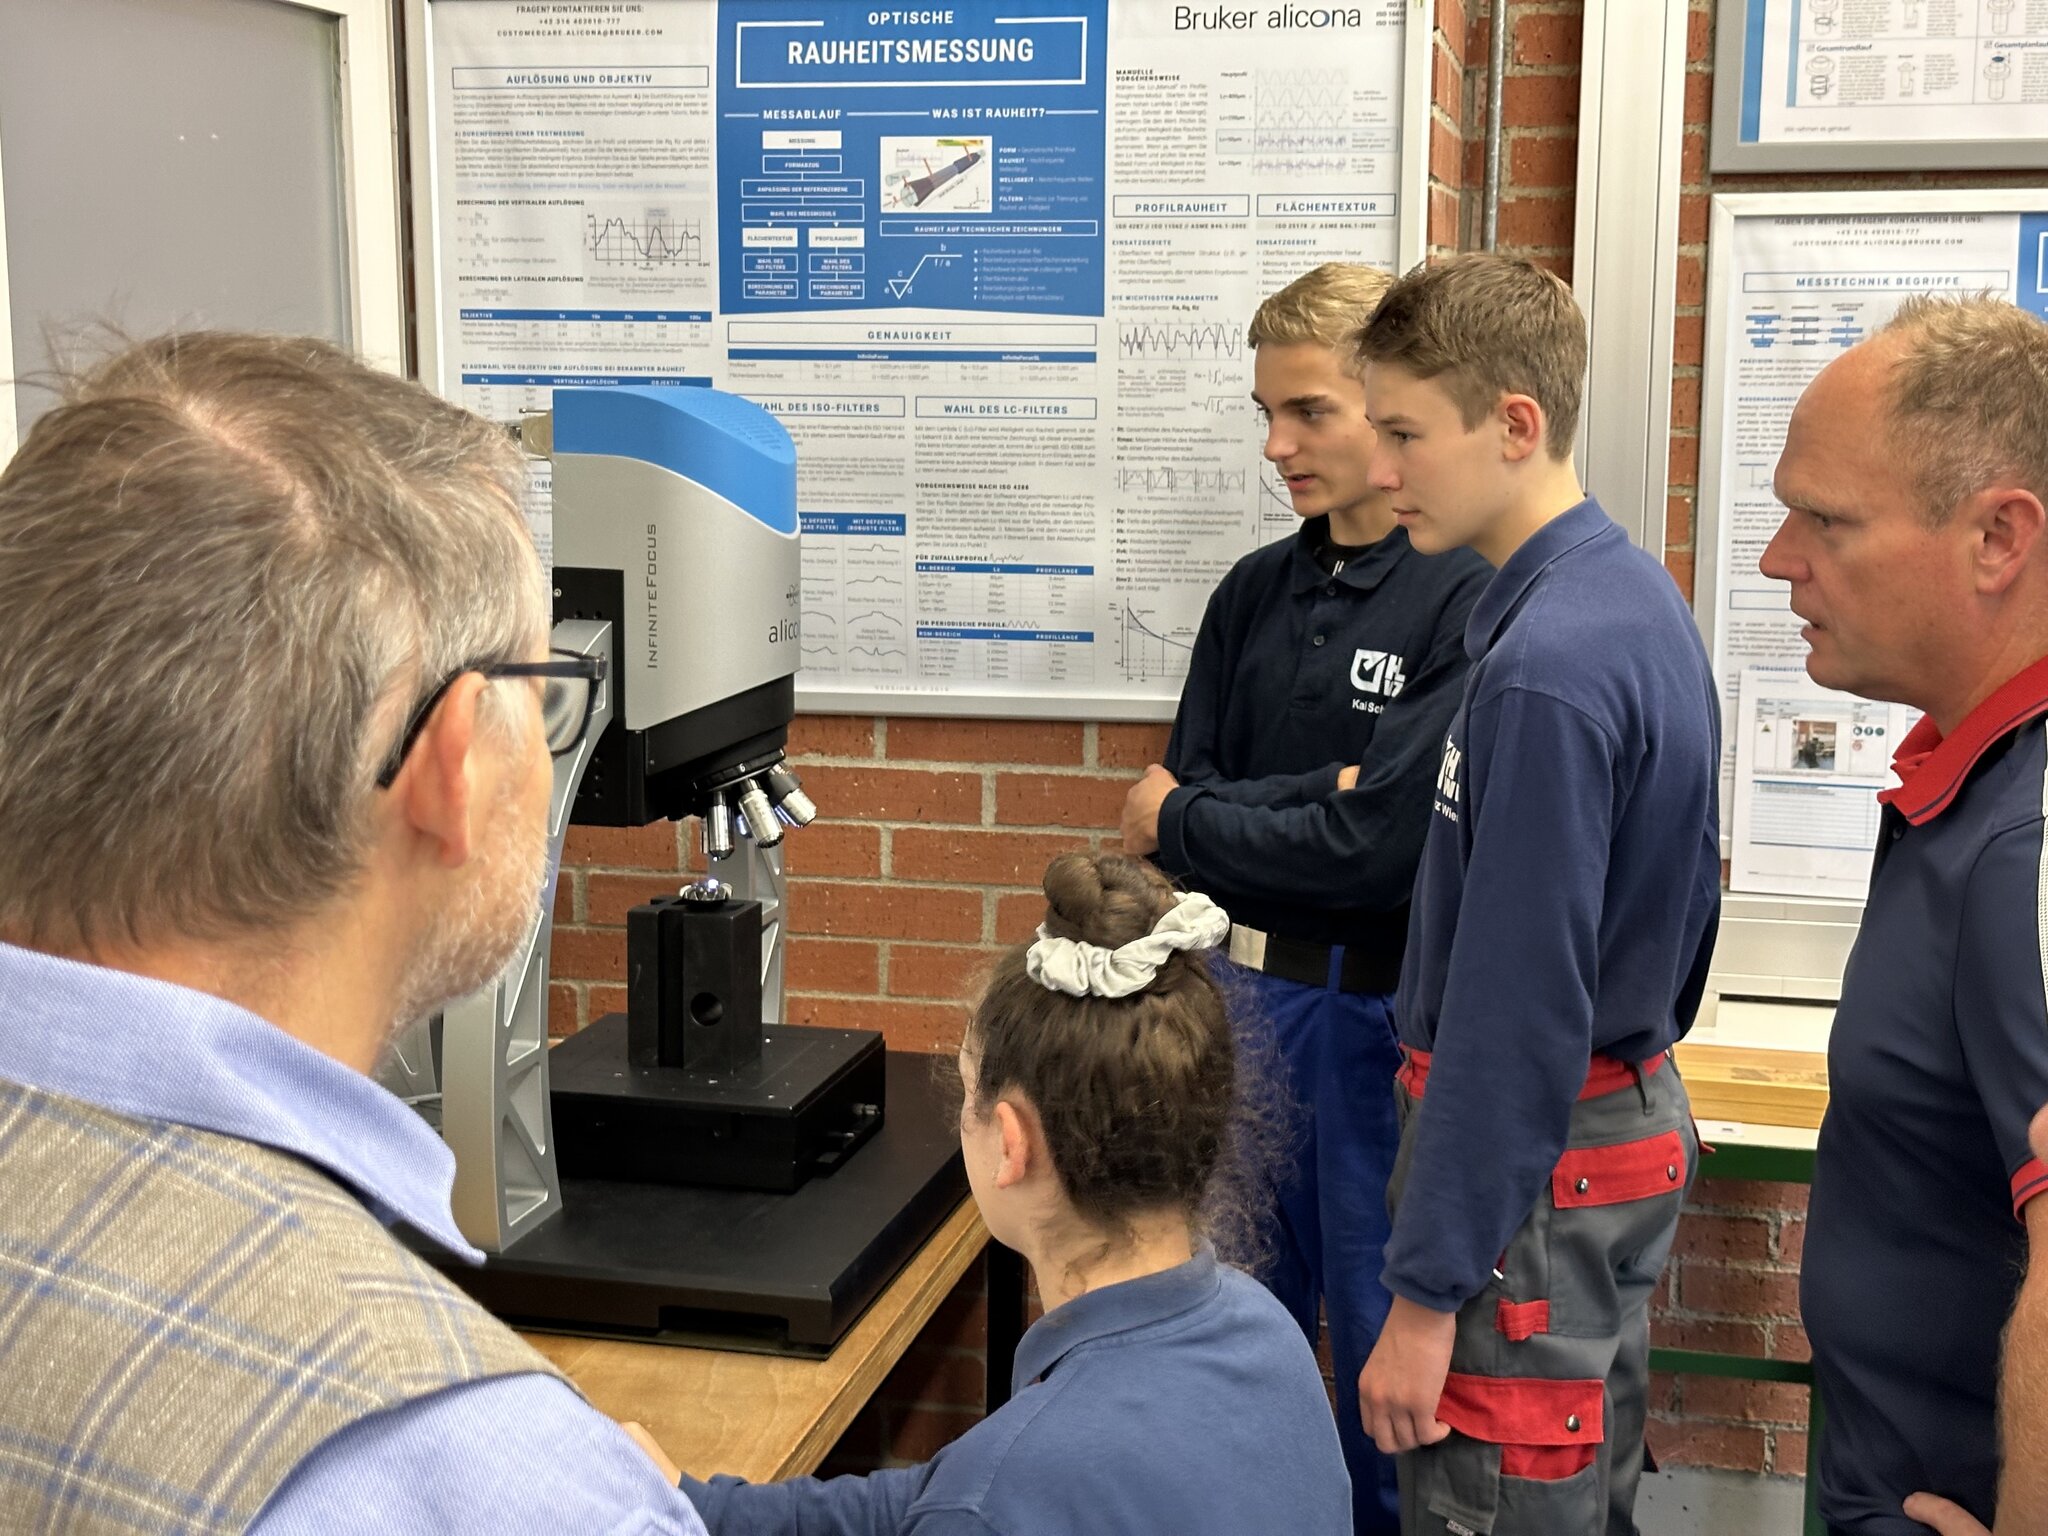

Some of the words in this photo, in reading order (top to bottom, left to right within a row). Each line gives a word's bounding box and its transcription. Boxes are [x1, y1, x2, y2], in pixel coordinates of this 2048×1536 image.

[868, 10, 954, 26] OPTISCHE
[1174, 6, 1259, 30] Bruker
[1267, 5, 1361, 28] alicona
[788, 38, 1034, 65] RAUHEITSMESSUNG
[506, 73, 570, 84] AUFLÖSUNG
[573, 74, 595, 84] UND
[599, 74, 652, 84] OBJEKTIV
[763, 109, 842, 120] MESSABLAUF
[932, 107, 958, 118] WAS
[962, 107, 982, 118] IST
[985, 106, 1045, 118] RAUHEIT?
[1135, 203, 1228, 212] PROFILRAUHEIT
[1276, 202, 1377, 212] FLÄCHENTEXTUR
[940, 243, 946, 252] b
[1796, 277, 1890, 287] MESSTECHNIK
[1896, 276, 1960, 286] BEGRIFFE
[907, 286, 913, 294] d
[867, 331, 953, 341] GENAUIGKEIT
[787, 402, 808, 412] DES
[812, 403, 880, 413] ISO-FILTERS
[944, 405, 976, 414] WAHL
[979, 405, 1000, 414] DES
[1004, 406, 1068, 415] LC-FILTERS
[646, 524, 657, 668] INFINITEFOCUS
[931, 620, 976, 628] PERIODISCHE
[768, 618, 800, 643] alico
[740, 763, 746, 772] 6
